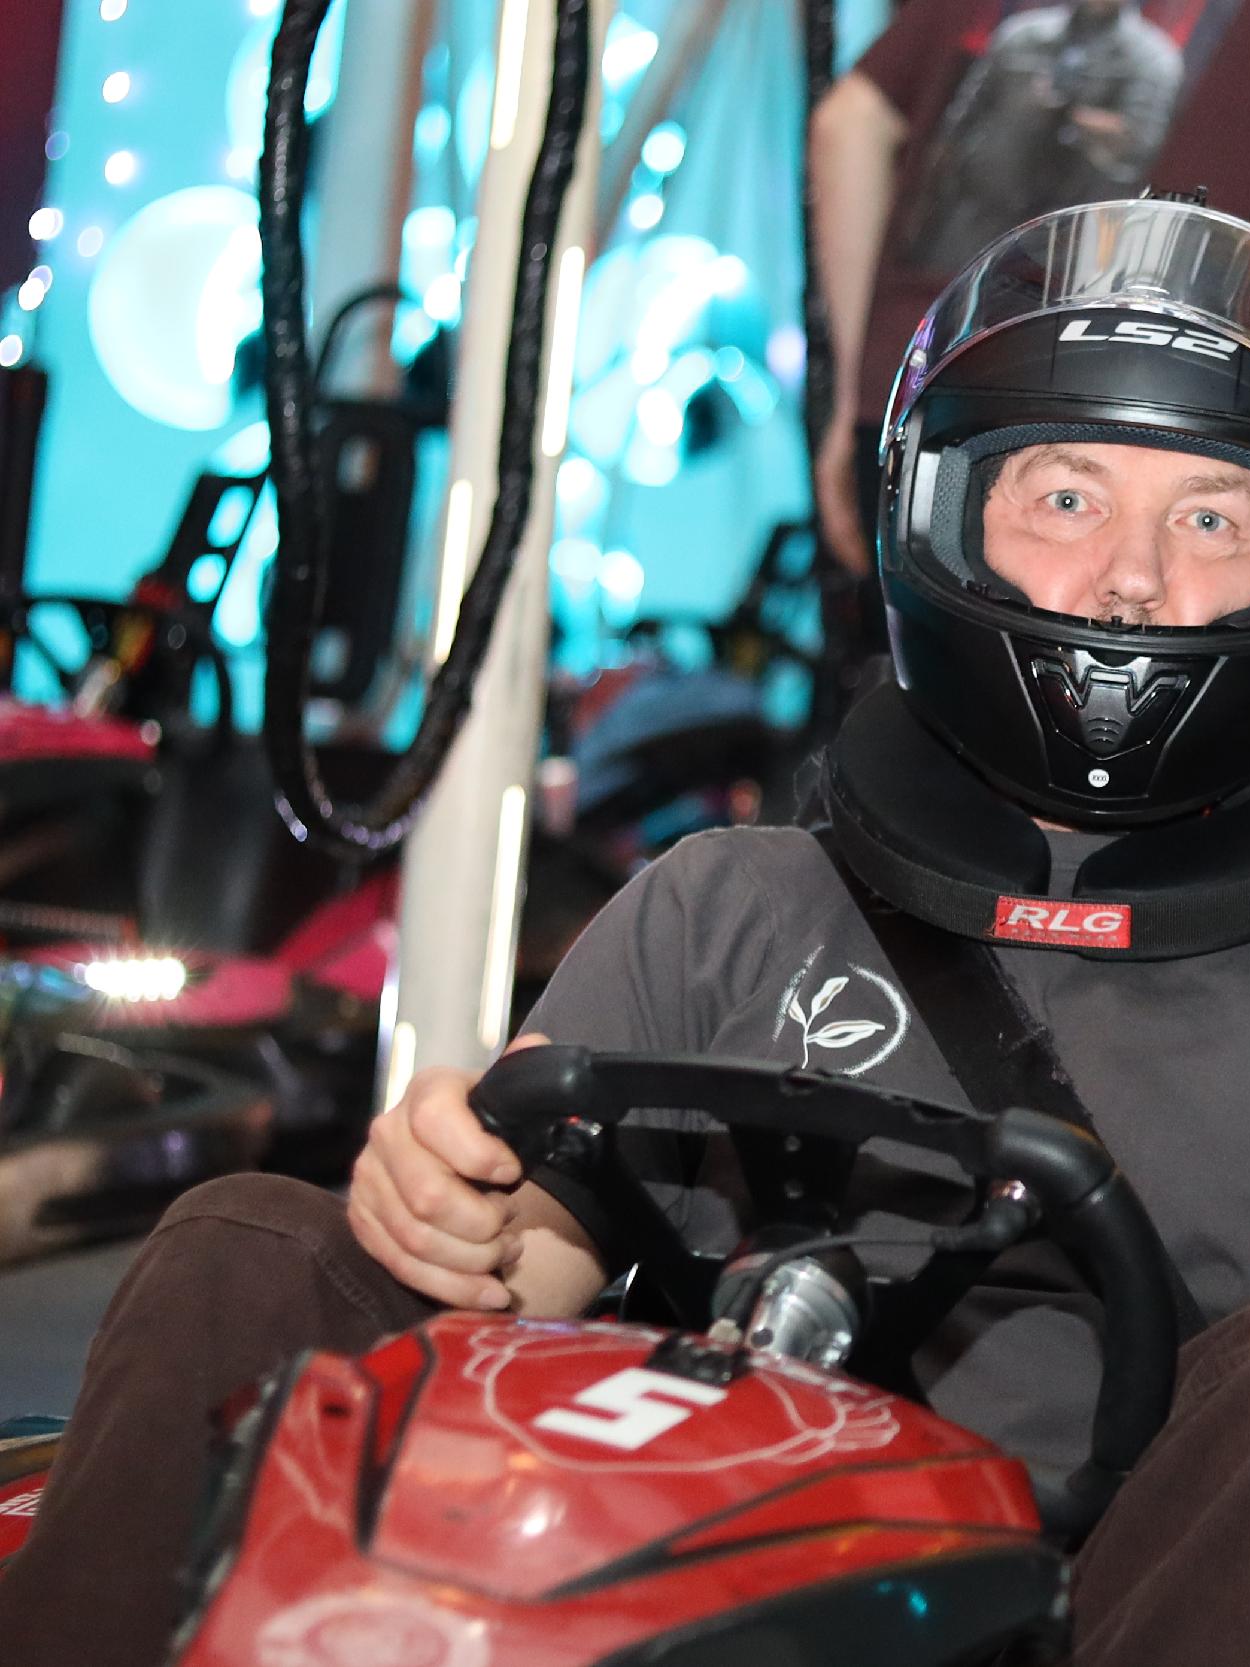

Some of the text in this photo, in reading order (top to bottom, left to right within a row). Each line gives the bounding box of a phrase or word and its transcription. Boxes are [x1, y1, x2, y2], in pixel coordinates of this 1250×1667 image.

[1059, 320, 1239, 361] LS2
[1007, 904, 1124, 932] RLG
[534, 1368, 727, 1449] 5
